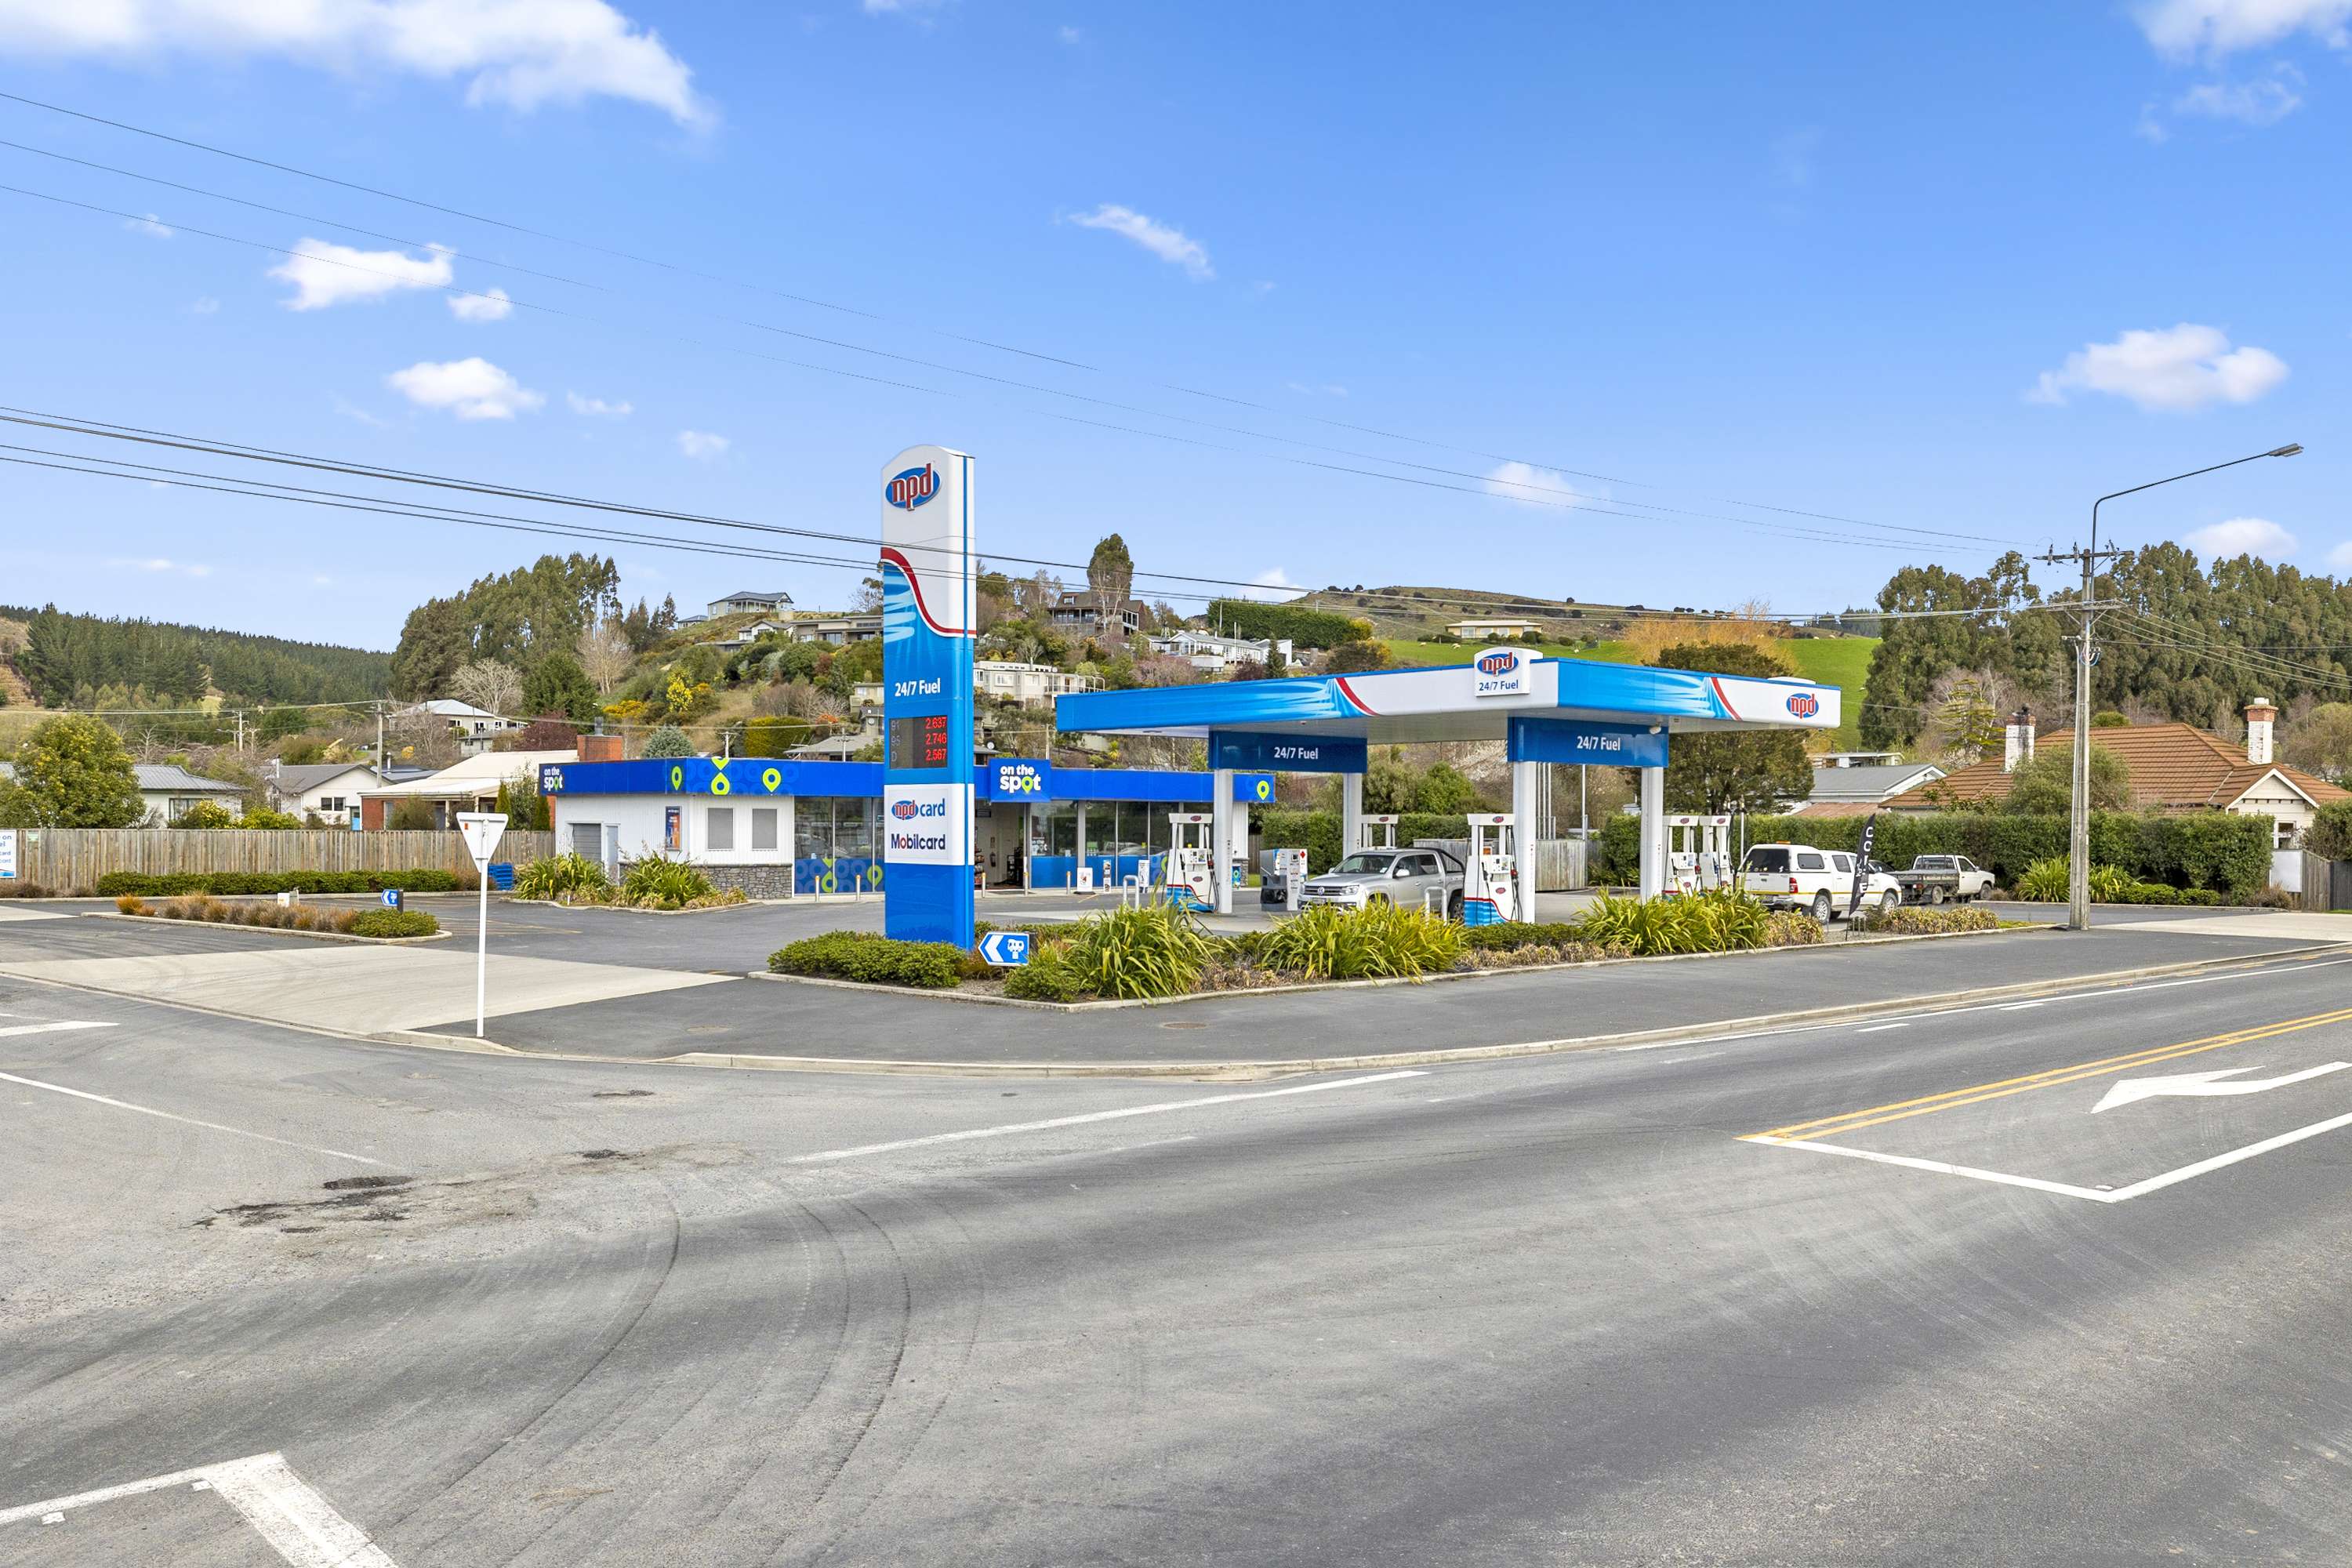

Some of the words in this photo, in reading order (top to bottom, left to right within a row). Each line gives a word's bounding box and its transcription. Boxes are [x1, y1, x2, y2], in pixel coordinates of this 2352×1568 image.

[890, 463, 933, 511] npd
[1482, 652, 1514, 677] npd
[895, 681, 917, 697] 24/7
[919, 677, 941, 695] Fuel
[1479, 681, 1498, 691] 24/7
[1500, 679, 1519, 690] Fuel
[1790, 693, 1815, 720] npd
[925, 732, 947, 746] 2.746
[1577, 735, 1599, 750] 24/7
[1600, 736, 1621, 751] Fuel
[1273, 746, 1296, 759] 24/7
[1298, 747, 1319, 760] Fuel
[551, 766, 560, 775] the
[1000, 765, 1014, 775] on
[1016, 764, 1035, 776] the
[544, 774, 563, 792] spot
[1000, 773, 1041, 794] spot
[895, 800, 916, 821] npd
[920, 798, 946, 817] card
[891, 833, 946, 850] Mobilcard
